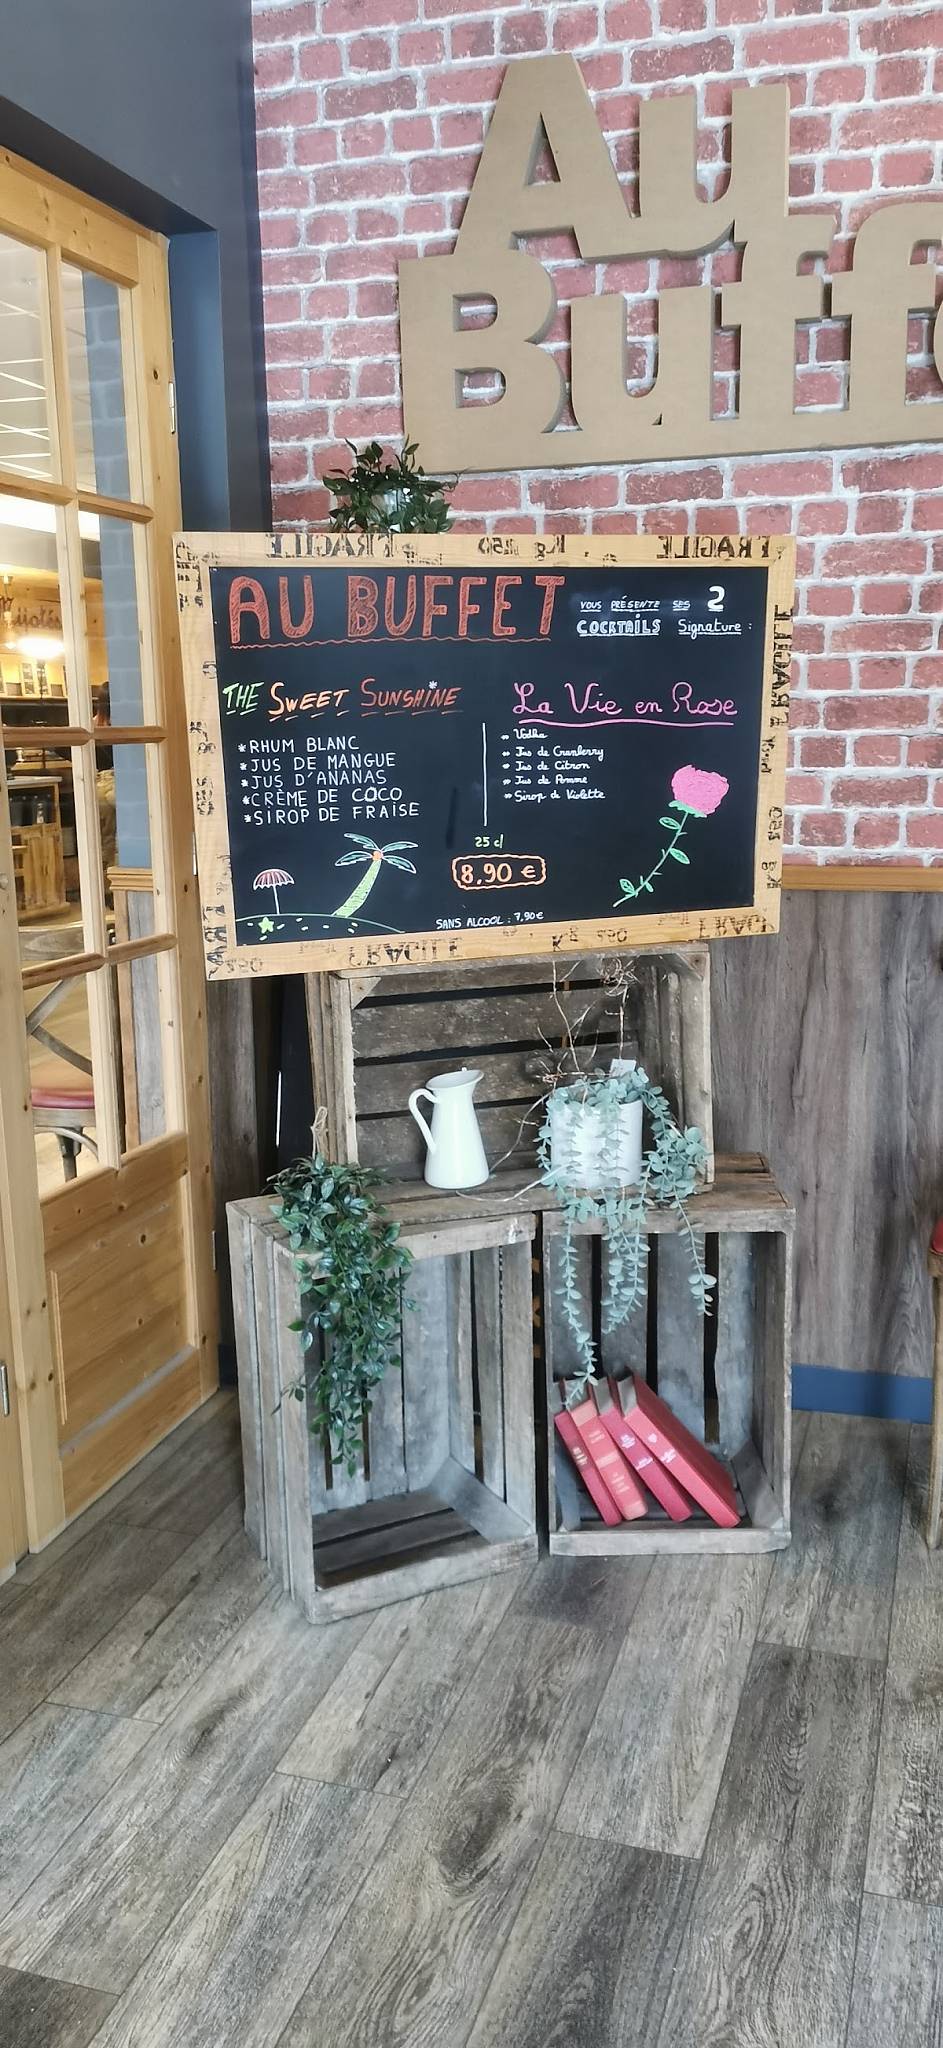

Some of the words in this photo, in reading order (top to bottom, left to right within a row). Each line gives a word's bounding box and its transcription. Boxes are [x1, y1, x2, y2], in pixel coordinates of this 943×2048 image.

[453, 53, 790, 259] Au
[399, 200, 943, 470] Buff
[580, 600, 602, 609] VOUS
[707, 585, 726, 610] 2
[229, 575, 314, 644] AU
[347, 574, 566, 637] BUFFET
[678, 618, 742, 640] Signature
[222, 681, 265, 709] THE
[512, 682, 554, 714] La
[564, 683, 622, 715] Vie
[635, 700, 663, 715] en
[672, 682, 738, 715] Rose
[250, 739, 295, 754] RHUM
[306, 736, 360, 753] BLANC
[537, 746, 550, 757] de
[251, 758, 282, 772] JUS
[293, 756, 317, 770] DE
[327, 752, 397, 770] MANGUE
[537, 761, 550, 771] de
[554, 760, 591, 771] Citron
[251, 775, 284, 790] JUS
[537, 774, 551, 785] de
[251, 788, 308, 807] CRÈME
[317, 788, 339, 804] DE
[351, 786, 403, 803] COCO
[514, 790, 547, 803] Sirop
[566, 788, 606, 800] Violette
[318, 807, 340, 822] DE
[474, 836, 490, 848] 25
[461, 863, 513, 884] 8,90
[520, 865, 536, 879] €
[436, 918, 462, 930] SANS
[466, 916, 504, 928] ALCOOL
